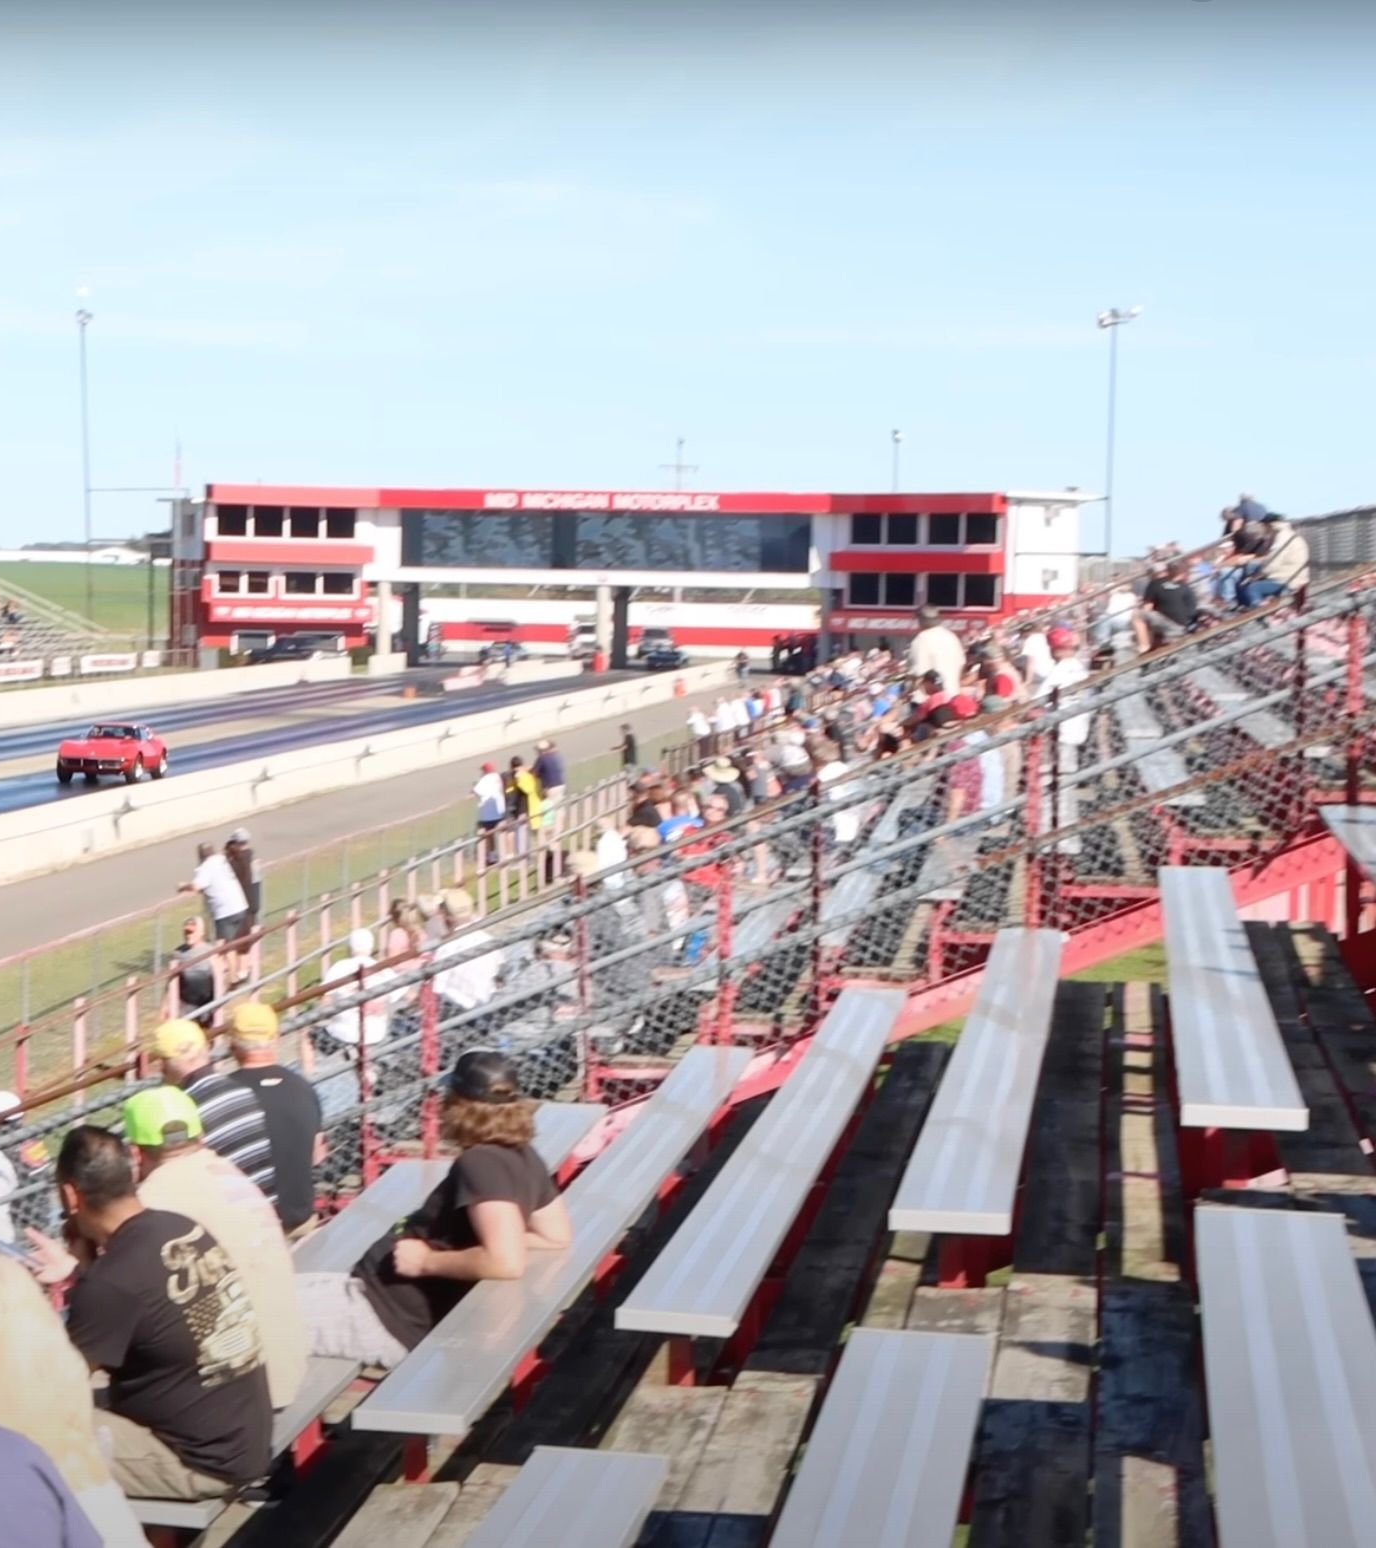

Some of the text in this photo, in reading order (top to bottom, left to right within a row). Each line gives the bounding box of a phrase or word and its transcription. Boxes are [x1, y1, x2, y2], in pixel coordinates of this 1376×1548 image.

[484, 492, 721, 511] MID MICHIGAN MOTORPLEX
